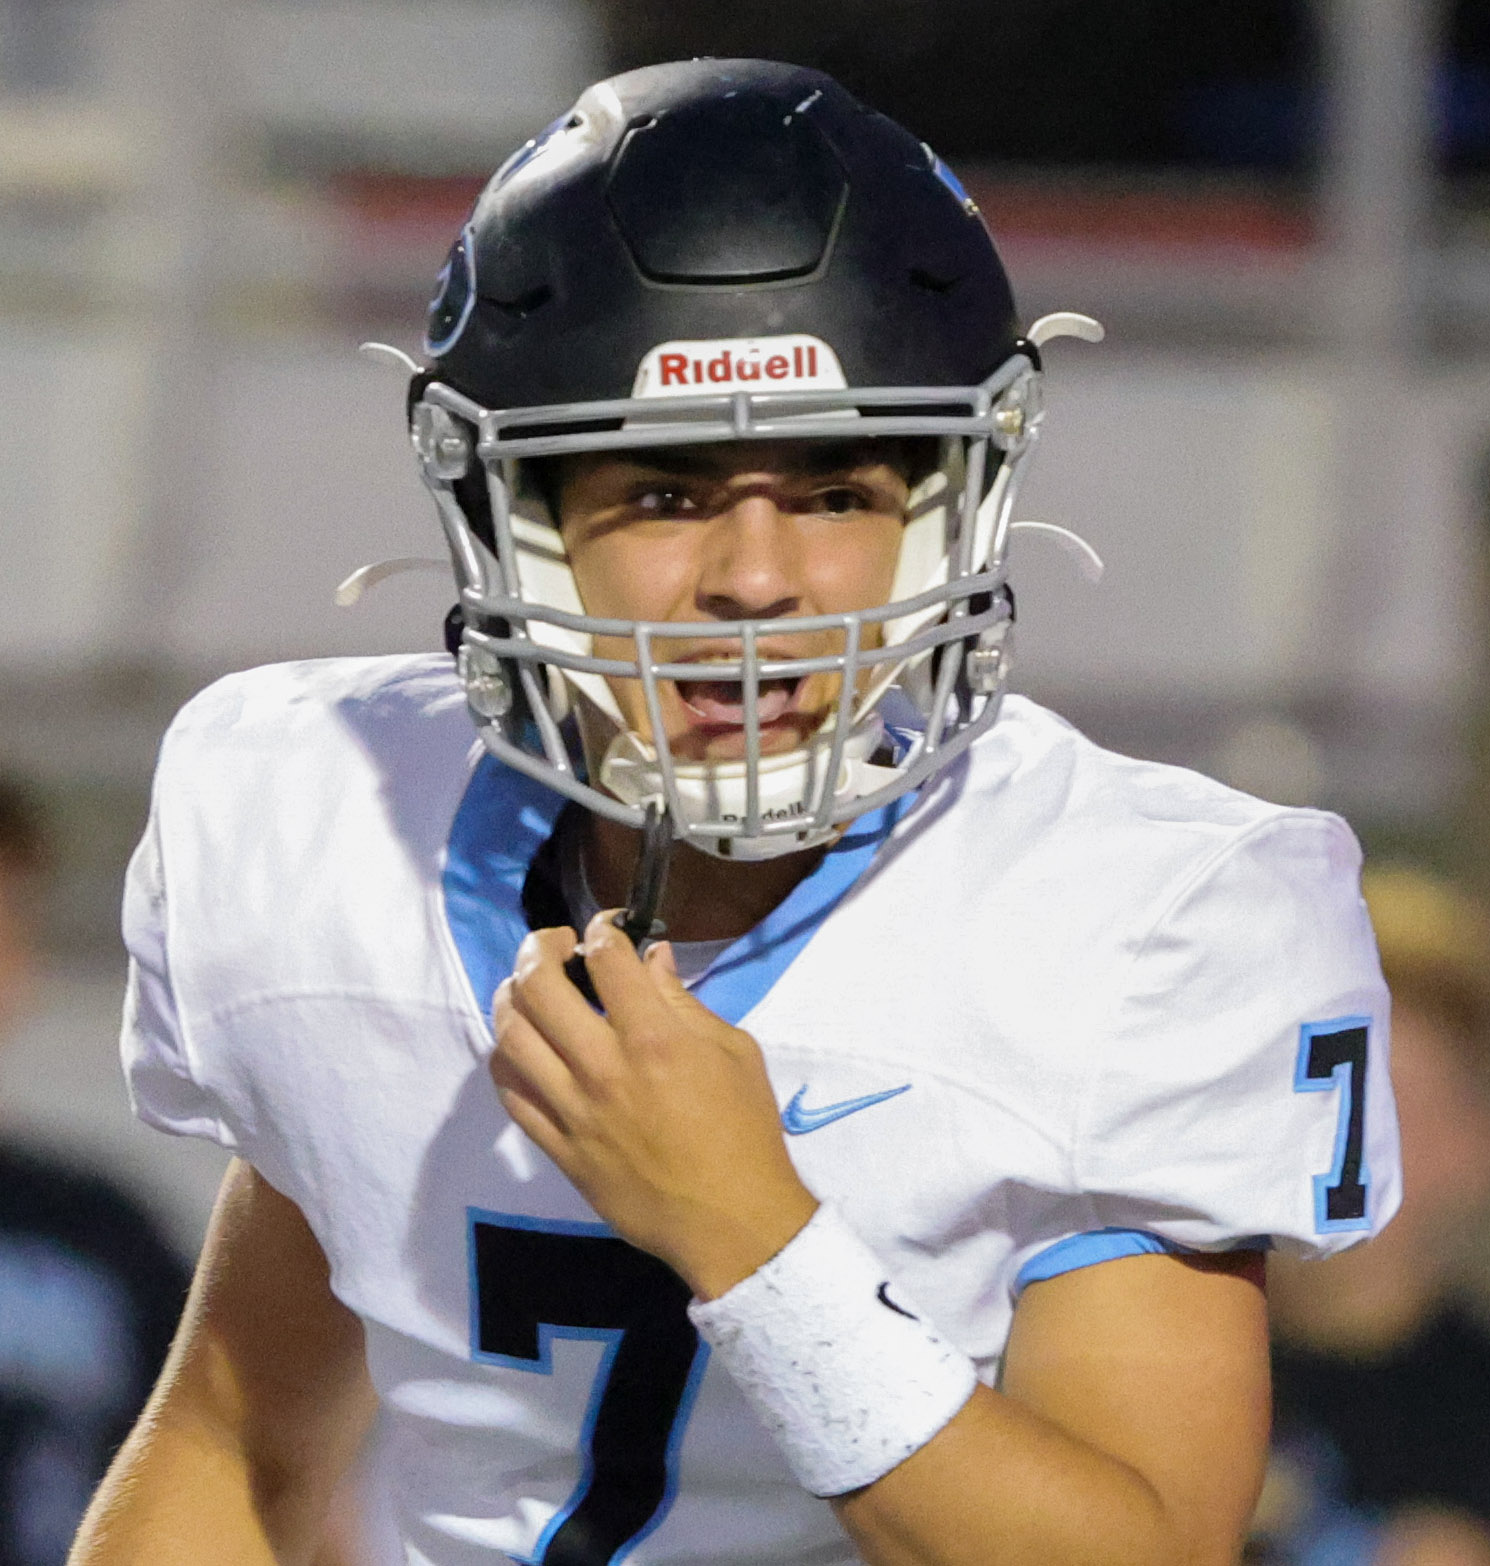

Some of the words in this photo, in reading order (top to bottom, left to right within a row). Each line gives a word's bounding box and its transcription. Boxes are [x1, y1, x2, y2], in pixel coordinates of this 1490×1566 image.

[660, 346, 817, 386] Riddell
[1294, 1015, 1373, 1234] 7
[466, 1205, 713, 1566] 7
